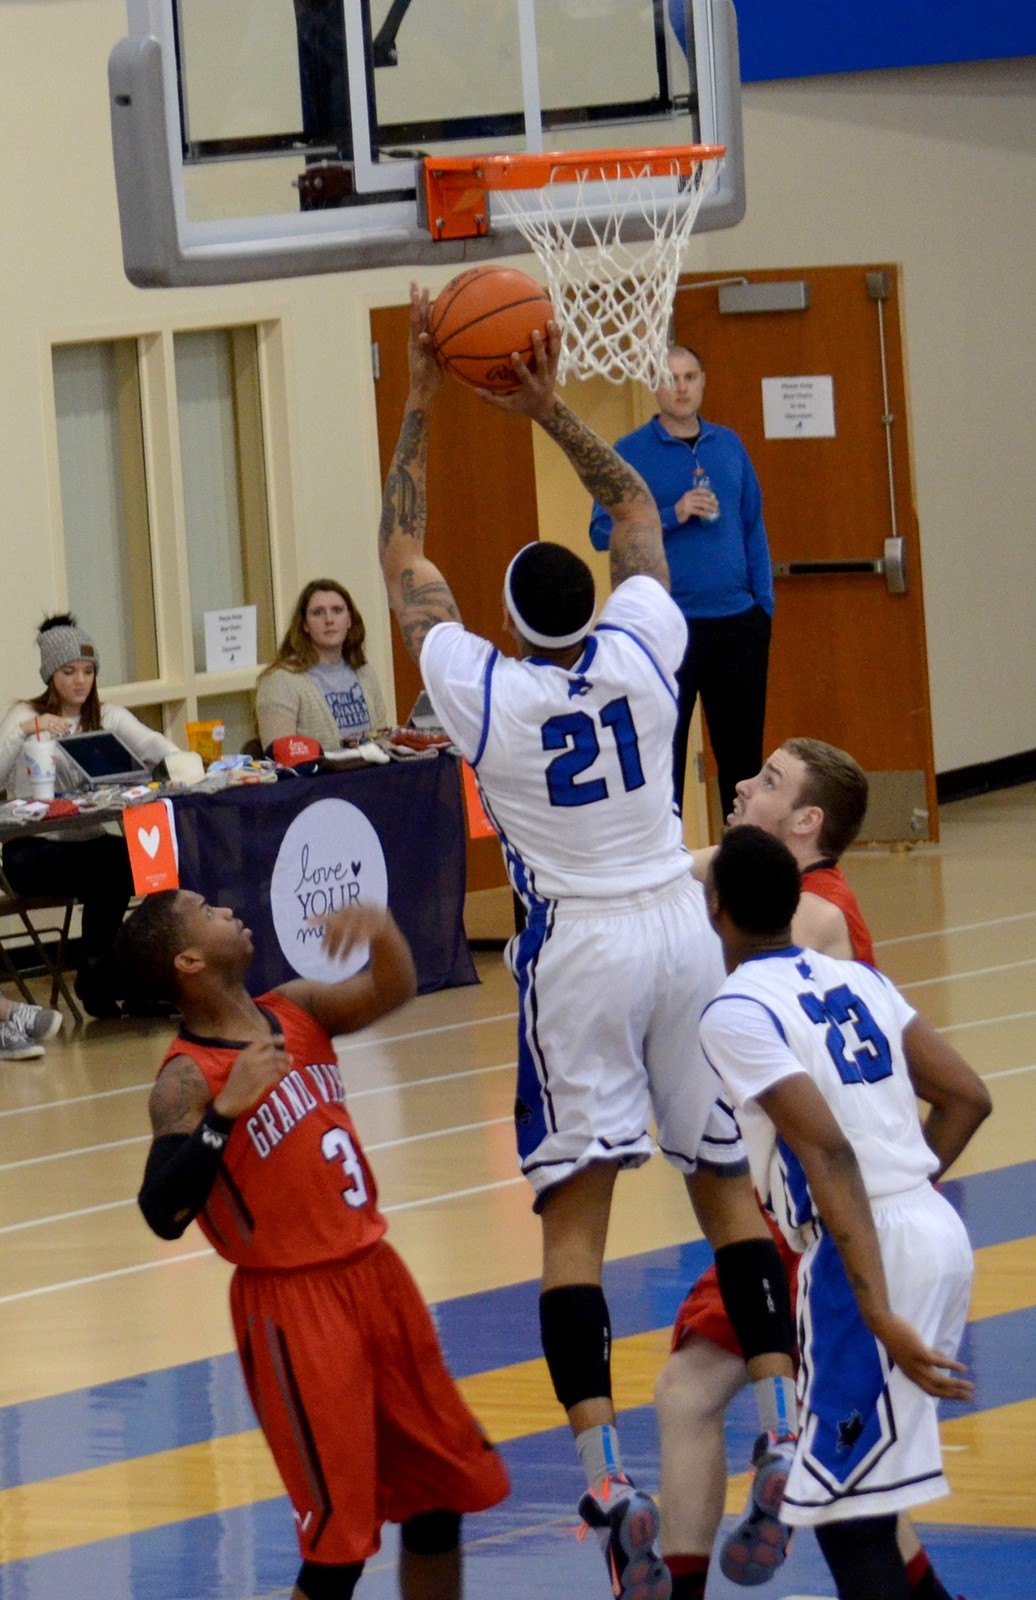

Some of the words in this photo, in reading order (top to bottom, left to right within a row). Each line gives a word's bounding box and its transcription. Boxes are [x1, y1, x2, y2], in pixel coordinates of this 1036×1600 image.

[541, 695, 646, 807] 21
[295, 843, 348, 893] love
[297, 881, 363, 920] YOUR
[797, 983, 893, 1085] 23
[246, 1070, 317, 1159] GRAND
[305, 1063, 346, 1103] VIE
[320, 1126, 369, 1210] 3
